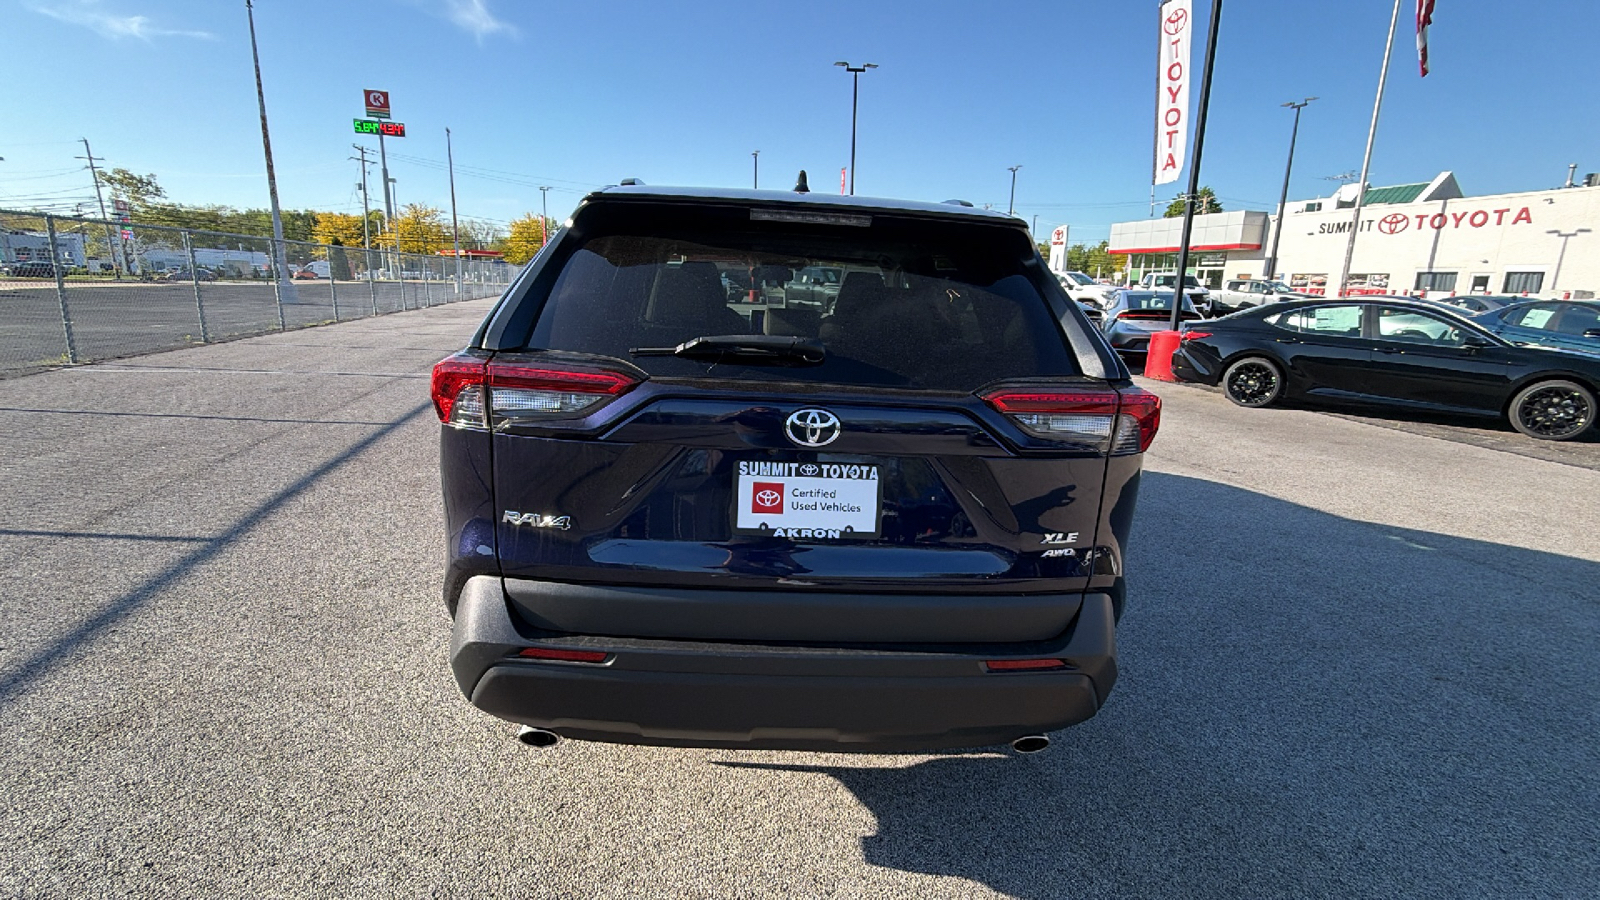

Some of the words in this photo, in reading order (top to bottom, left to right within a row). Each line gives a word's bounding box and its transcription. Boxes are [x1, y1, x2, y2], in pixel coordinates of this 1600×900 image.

[1162, 38, 1183, 171] TOYOTA
[1415, 207, 1533, 230] TOYOTA
[739, 461, 799, 477] SUMMIT
[821, 464, 879, 480] TOYOTA
[791, 488, 837, 499] Certified
[791, 501, 818, 511] Used
[819, 502, 861, 513] Vehicles
[502, 510, 571, 530] RAV4
[773, 527, 840, 539] AKRON
[1040, 532, 1079, 544] XLE
[1040, 548, 1076, 558] AWD
